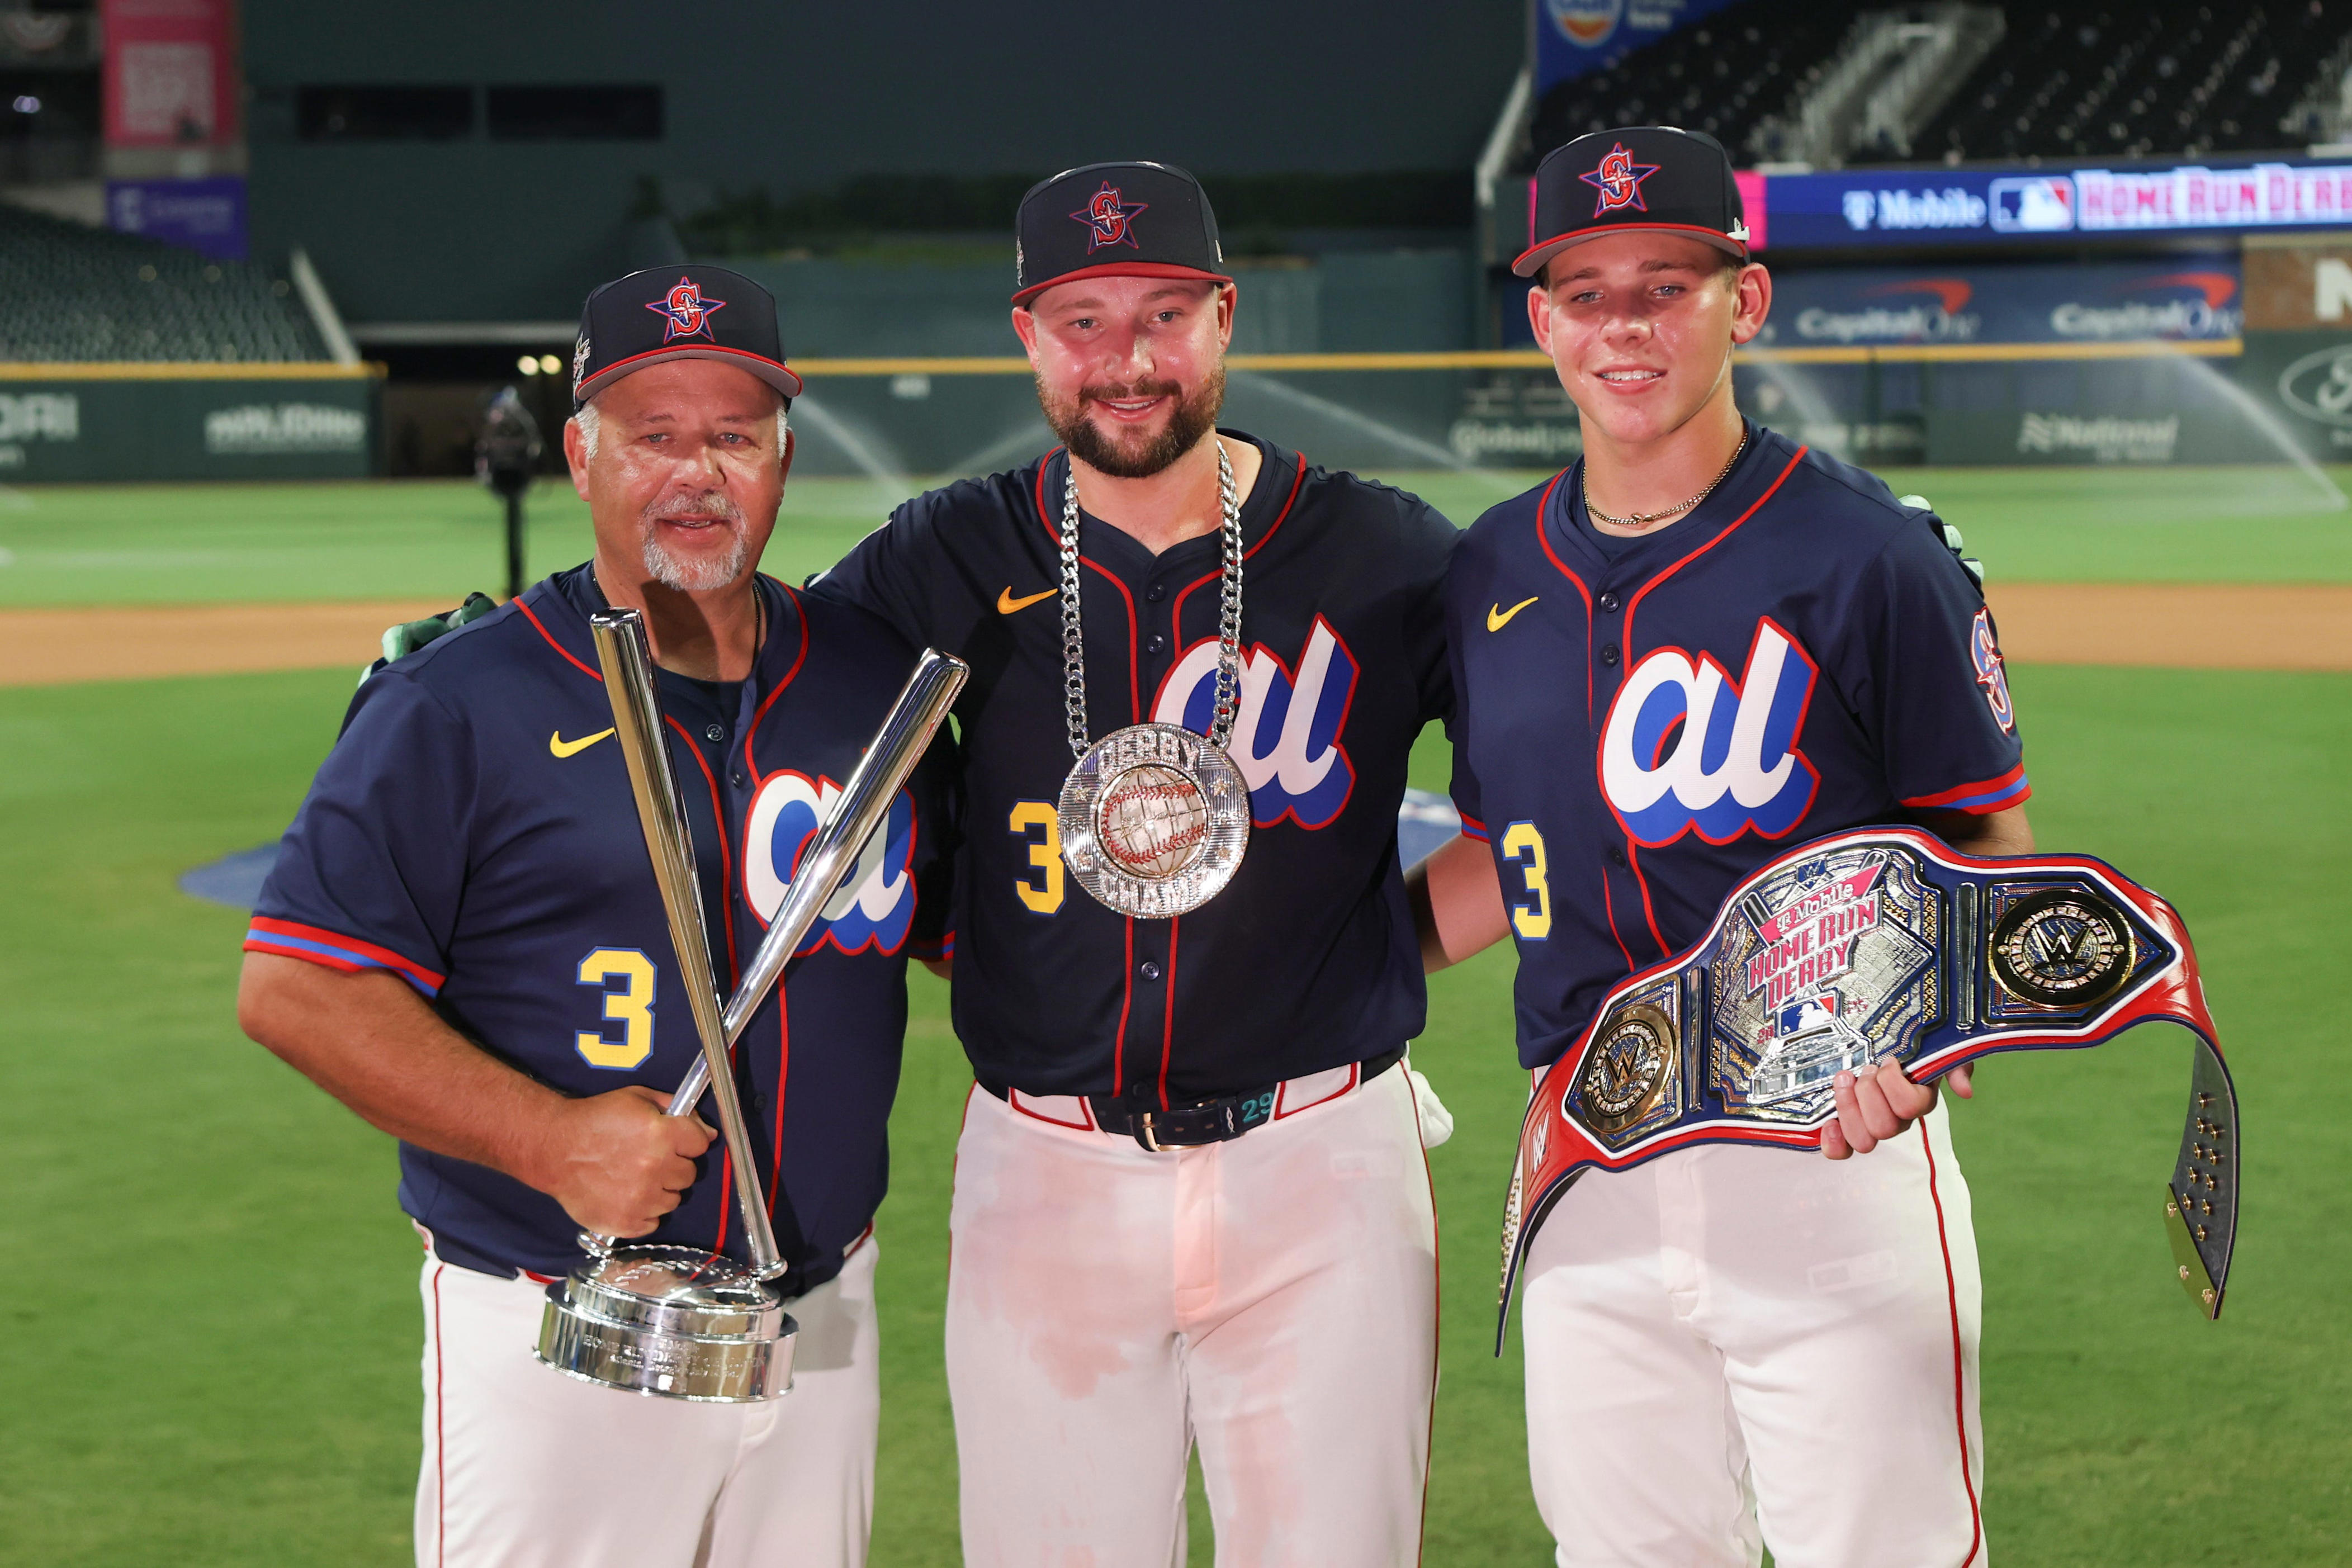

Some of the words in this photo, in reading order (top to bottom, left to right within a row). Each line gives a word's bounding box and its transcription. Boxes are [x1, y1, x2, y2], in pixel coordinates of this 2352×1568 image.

[1878, 188, 1987, 229] Mobile
[2079, 171, 2175, 228] HOME
[2179, 168, 2256, 225] RUN
[1009, 798, 1067, 917] 3
[1500, 819, 1553, 940] 3
[1749, 928, 1815, 991] HOME
[1819, 899, 1876, 947] RUN
[1793, 883, 1854, 925] Mobile
[575, 946, 658, 1070] 3
[1768, 938, 1851, 1011] DERBY
[1242, 1092, 1275, 1123] 29
